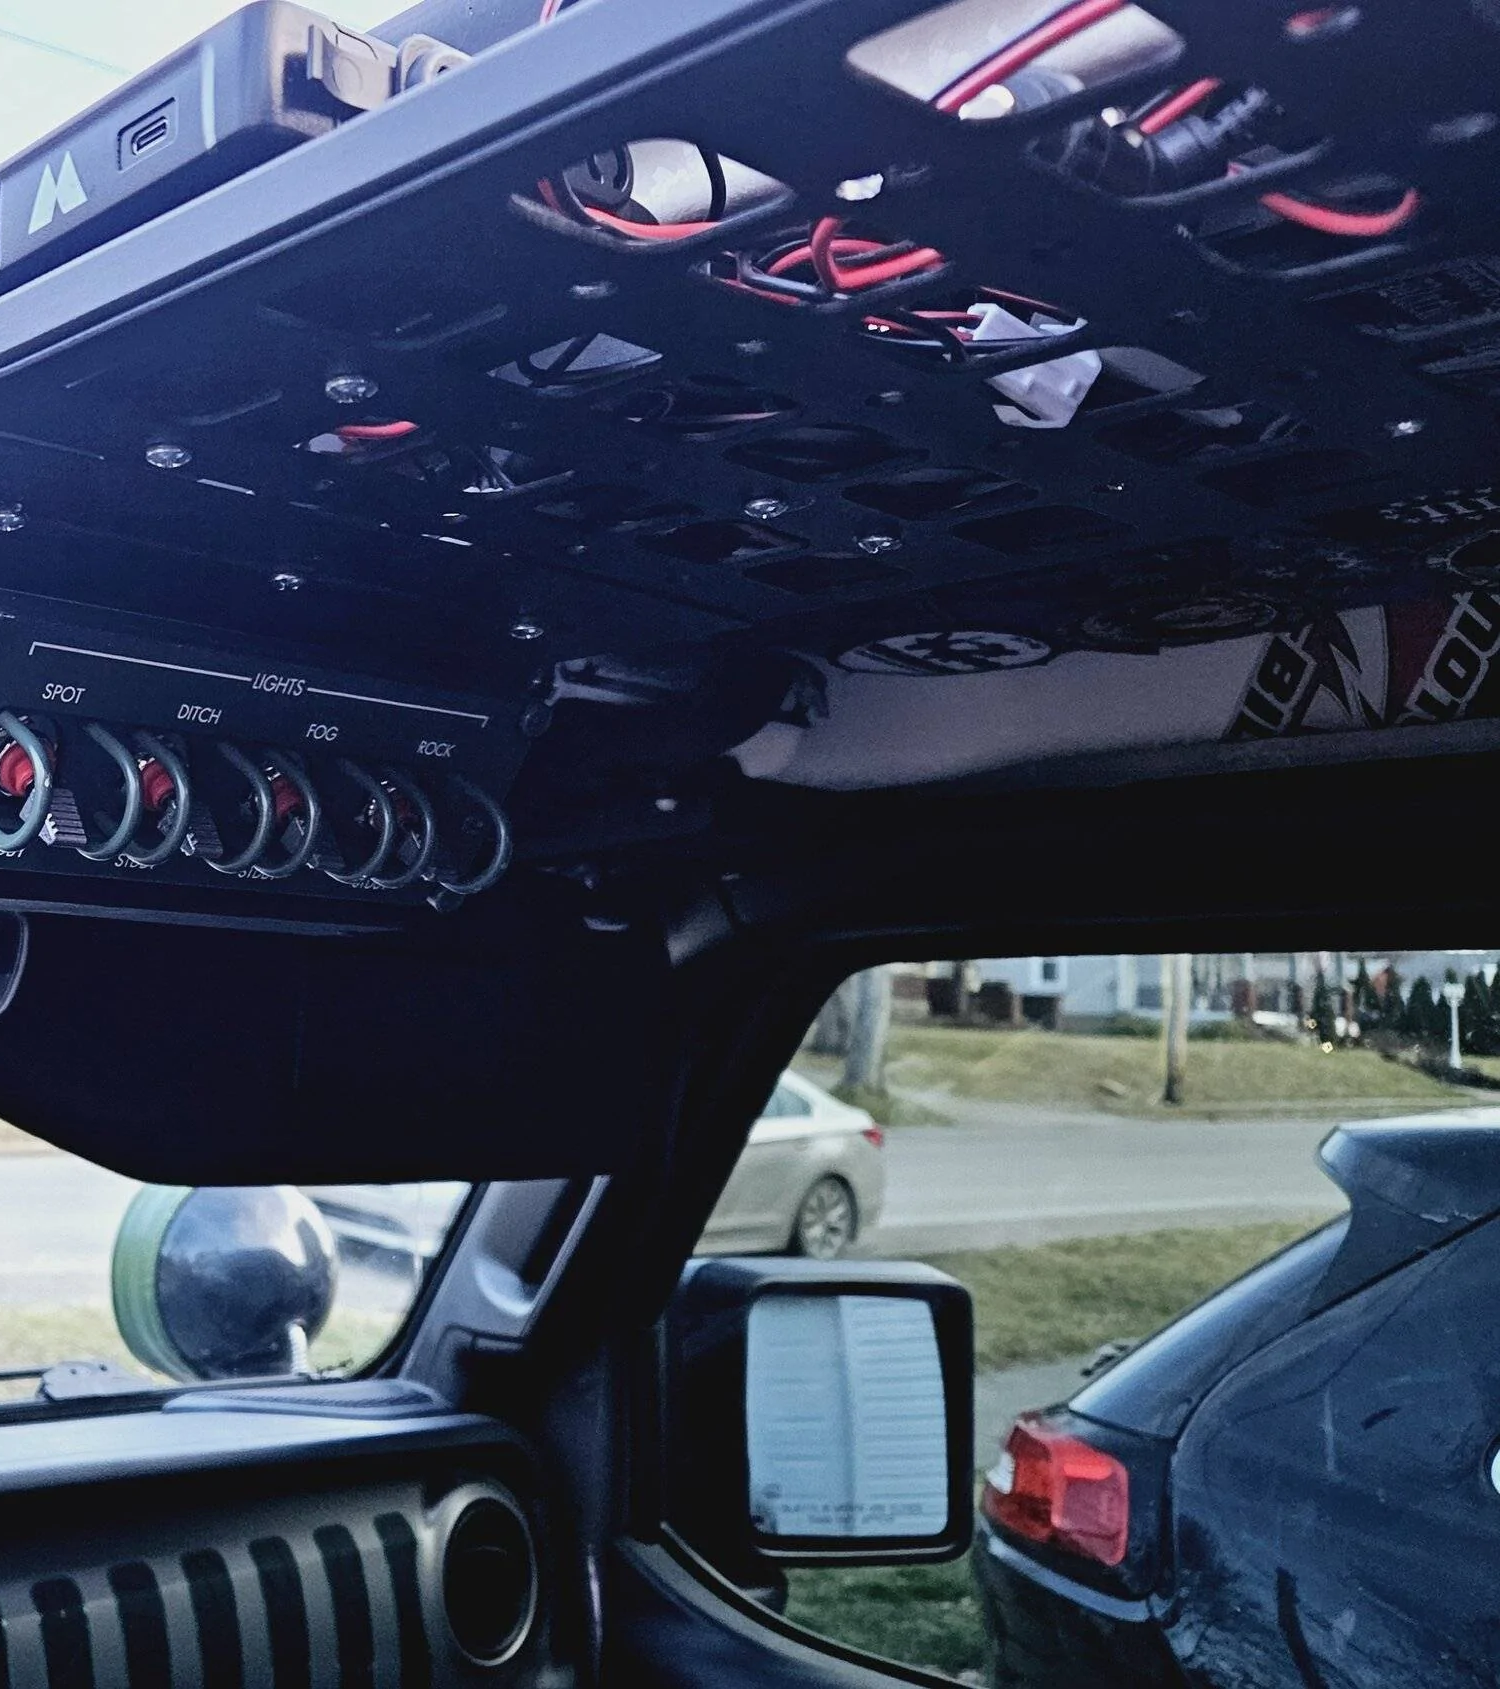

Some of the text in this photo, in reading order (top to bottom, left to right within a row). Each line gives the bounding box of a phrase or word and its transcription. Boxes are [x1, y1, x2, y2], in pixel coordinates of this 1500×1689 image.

[42, 683, 86, 704] SPOT
[252, 672, 307, 697] LIGHTS
[177, 703, 223, 725] DITCH
[306, 723, 339, 742] FOG
[416, 740, 457, 758] ROCK
